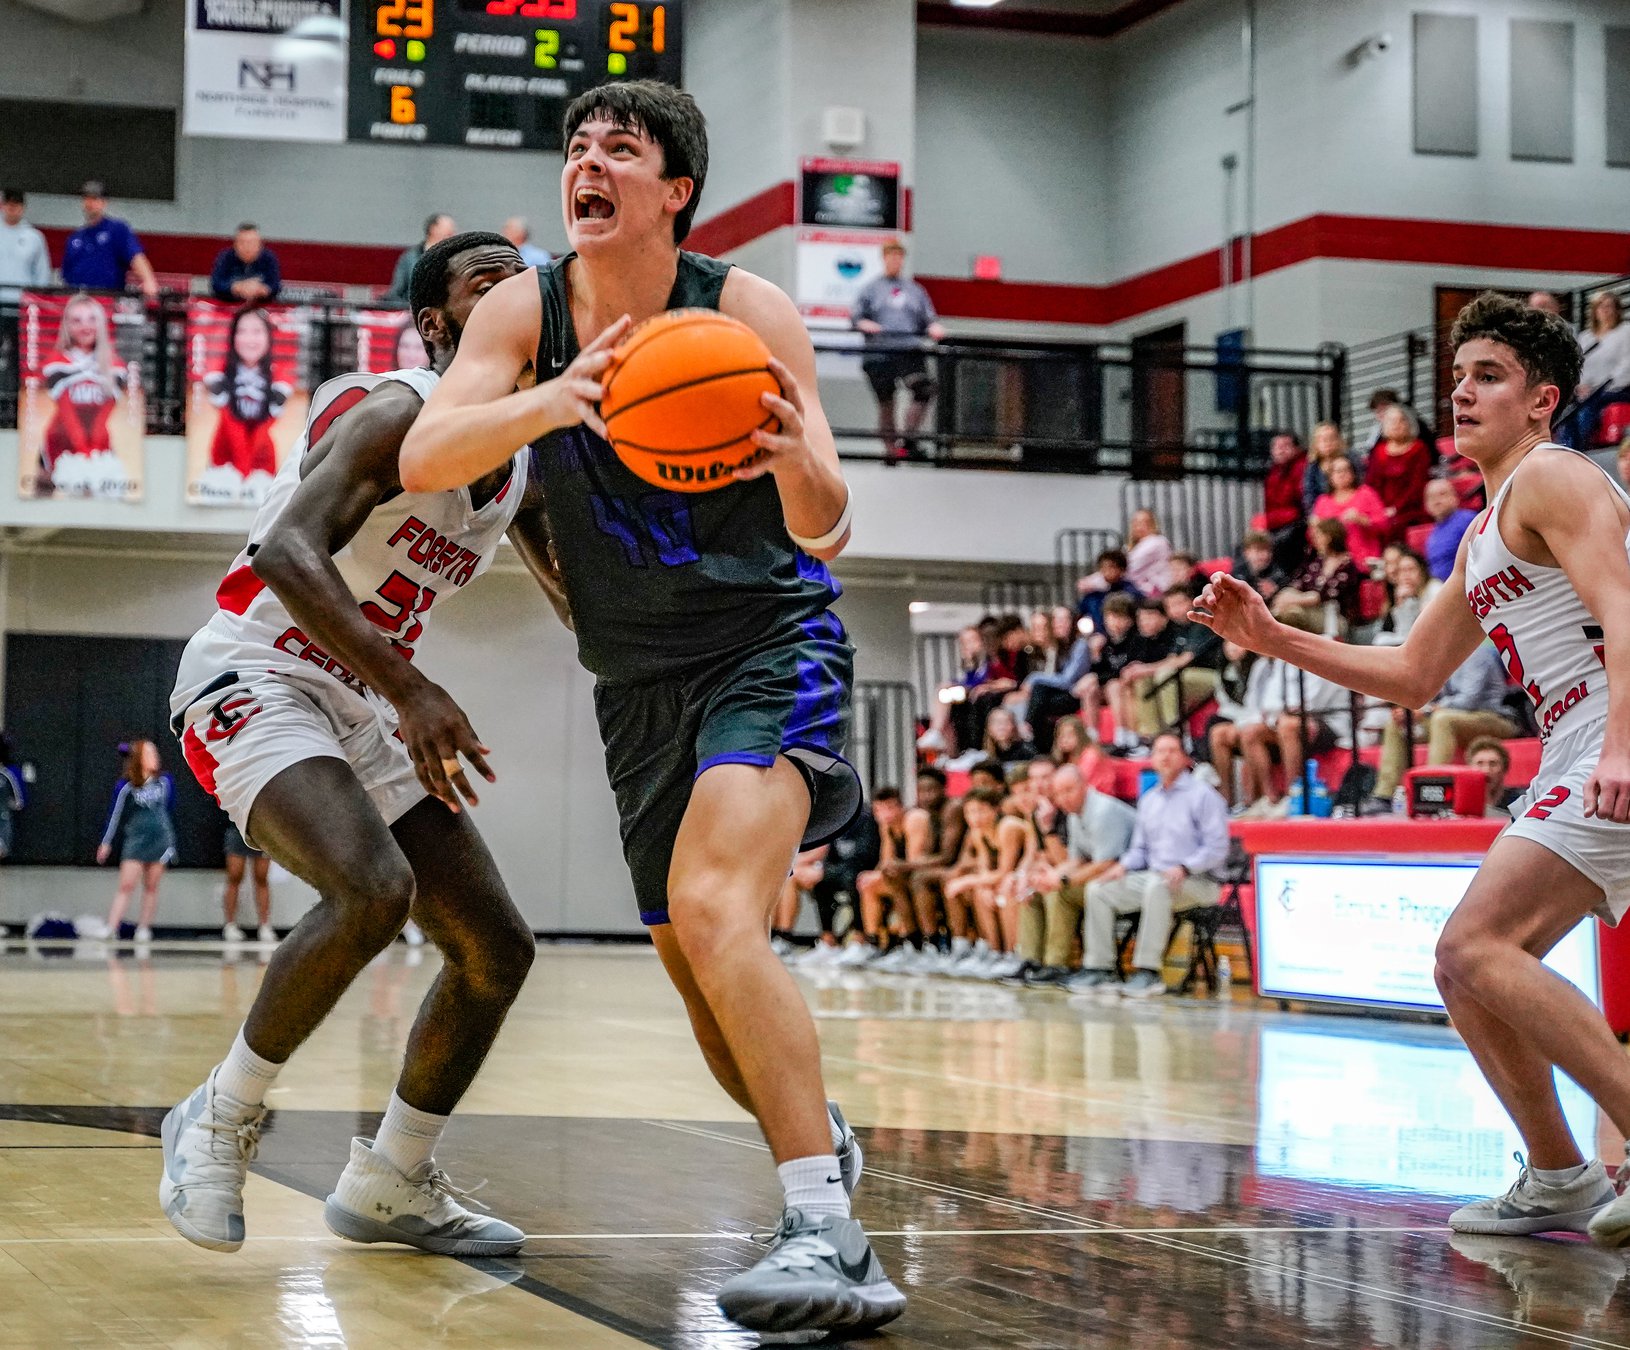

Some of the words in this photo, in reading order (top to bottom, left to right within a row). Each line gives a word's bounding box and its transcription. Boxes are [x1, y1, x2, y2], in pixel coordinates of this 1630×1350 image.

[377, 0, 434, 39] 23
[609, 2, 665, 53] 21
[534, 28, 560, 70] 2
[391, 84, 416, 124] 6
[386, 514, 482, 588] FORSYTH
[1523, 785, 1571, 822] 2
